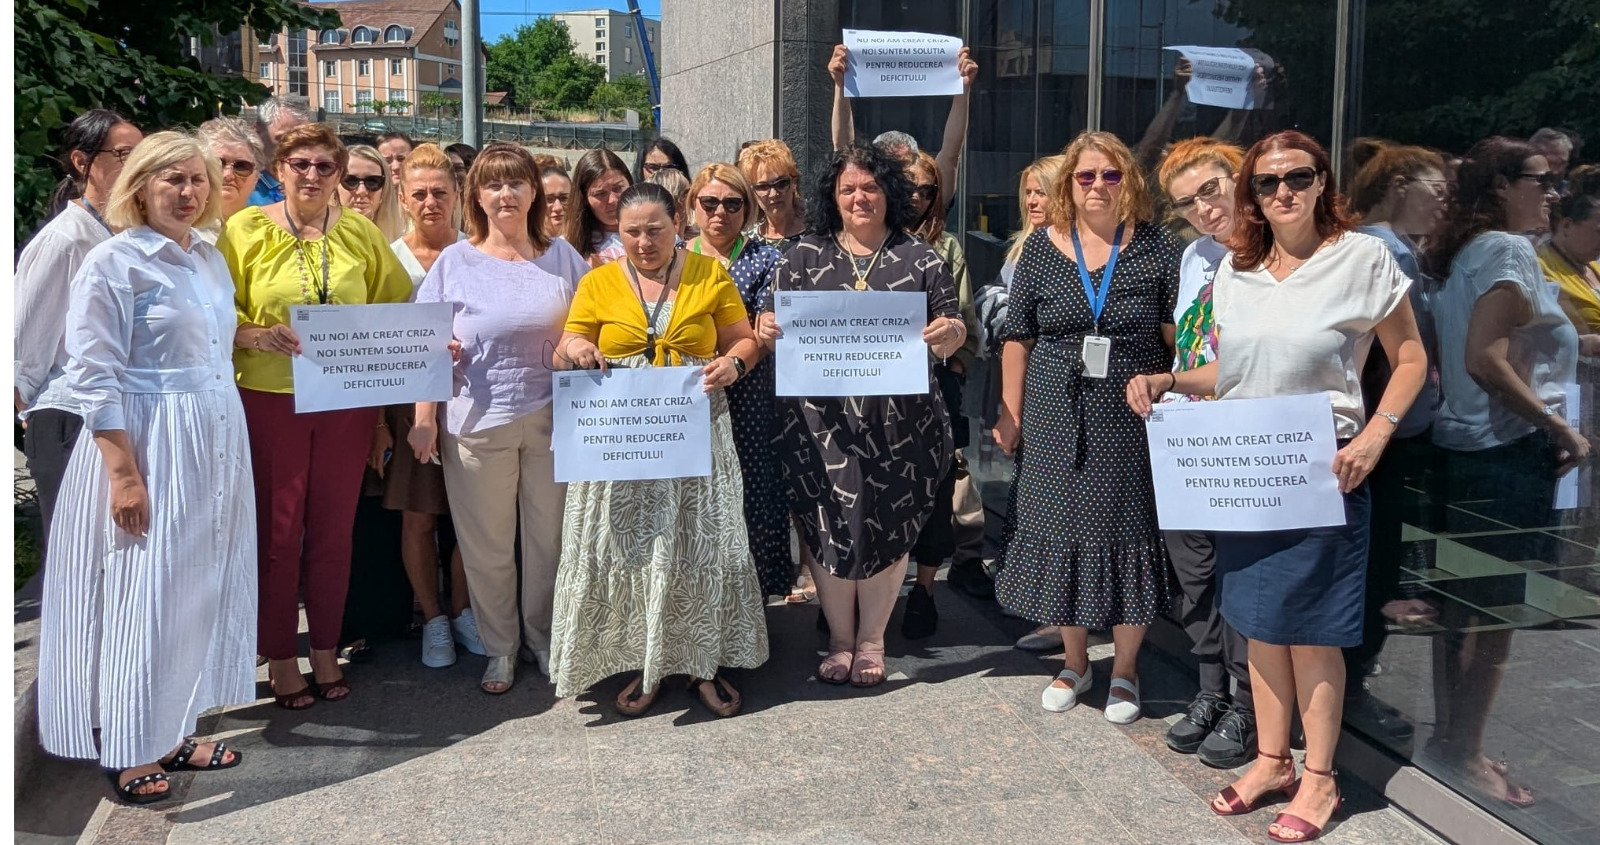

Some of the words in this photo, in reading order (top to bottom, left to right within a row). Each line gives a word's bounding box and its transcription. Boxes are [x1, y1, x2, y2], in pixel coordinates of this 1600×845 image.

[810, 319, 827, 327] NOI
[830, 319, 847, 327] AM
[329, 333, 348, 341] NOI
[352, 332, 369, 340] AM
[373, 331, 404, 339] CREAT
[407, 329, 435, 337] CRIZA
[799, 336, 816, 344] NOI
[819, 335, 860, 344] SUNTEM
[863, 334, 904, 343] SOLUTIA
[317, 349, 336, 357] NOI
[340, 347, 383, 357] SUNTEM
[387, 345, 429, 354] SOLUTIA
[804, 353, 842, 361] PENTRU
[845, 352, 902, 360] REDUCEREA
[323, 365, 363, 375] PENTRU
[368, 361, 426, 372] REDUCEREA
[823, 368, 881, 377] DEFICITULUI
[344, 378, 405, 390] DEFICITULUI
[571, 401, 586, 409] NU
[590, 400, 608, 408] NOI
[611, 399, 627, 407] AM
[631, 398, 661, 406] CREAT
[664, 397, 693, 405] CRIZA
[578, 418, 596, 426] NOI
[599, 416, 642, 426] SUNTEM
[645, 415, 687, 424] SOLUTIA
[584, 435, 622, 444] PENTRU
[626, 432, 685, 443] REDUCEREA
[1167, 438, 1184, 447] NU
[1188, 437, 1208, 446] NOI
[1212, 436, 1231, 446] AM
[1236, 435, 1272, 445] CREAT
[1276, 432, 1313, 443] CRIZA
[603, 451, 663, 461] DEFICITULUI
[1177, 458, 1197, 467] NOI
[1201, 457, 1250, 467] SUNTEM
[1254, 454, 1308, 465] SOLUTIA
[1186, 478, 1229, 488] PENTRU
[1234, 475, 1307, 487] REDUCEREA
[1210, 497, 1281, 508] DEFICITULUI
